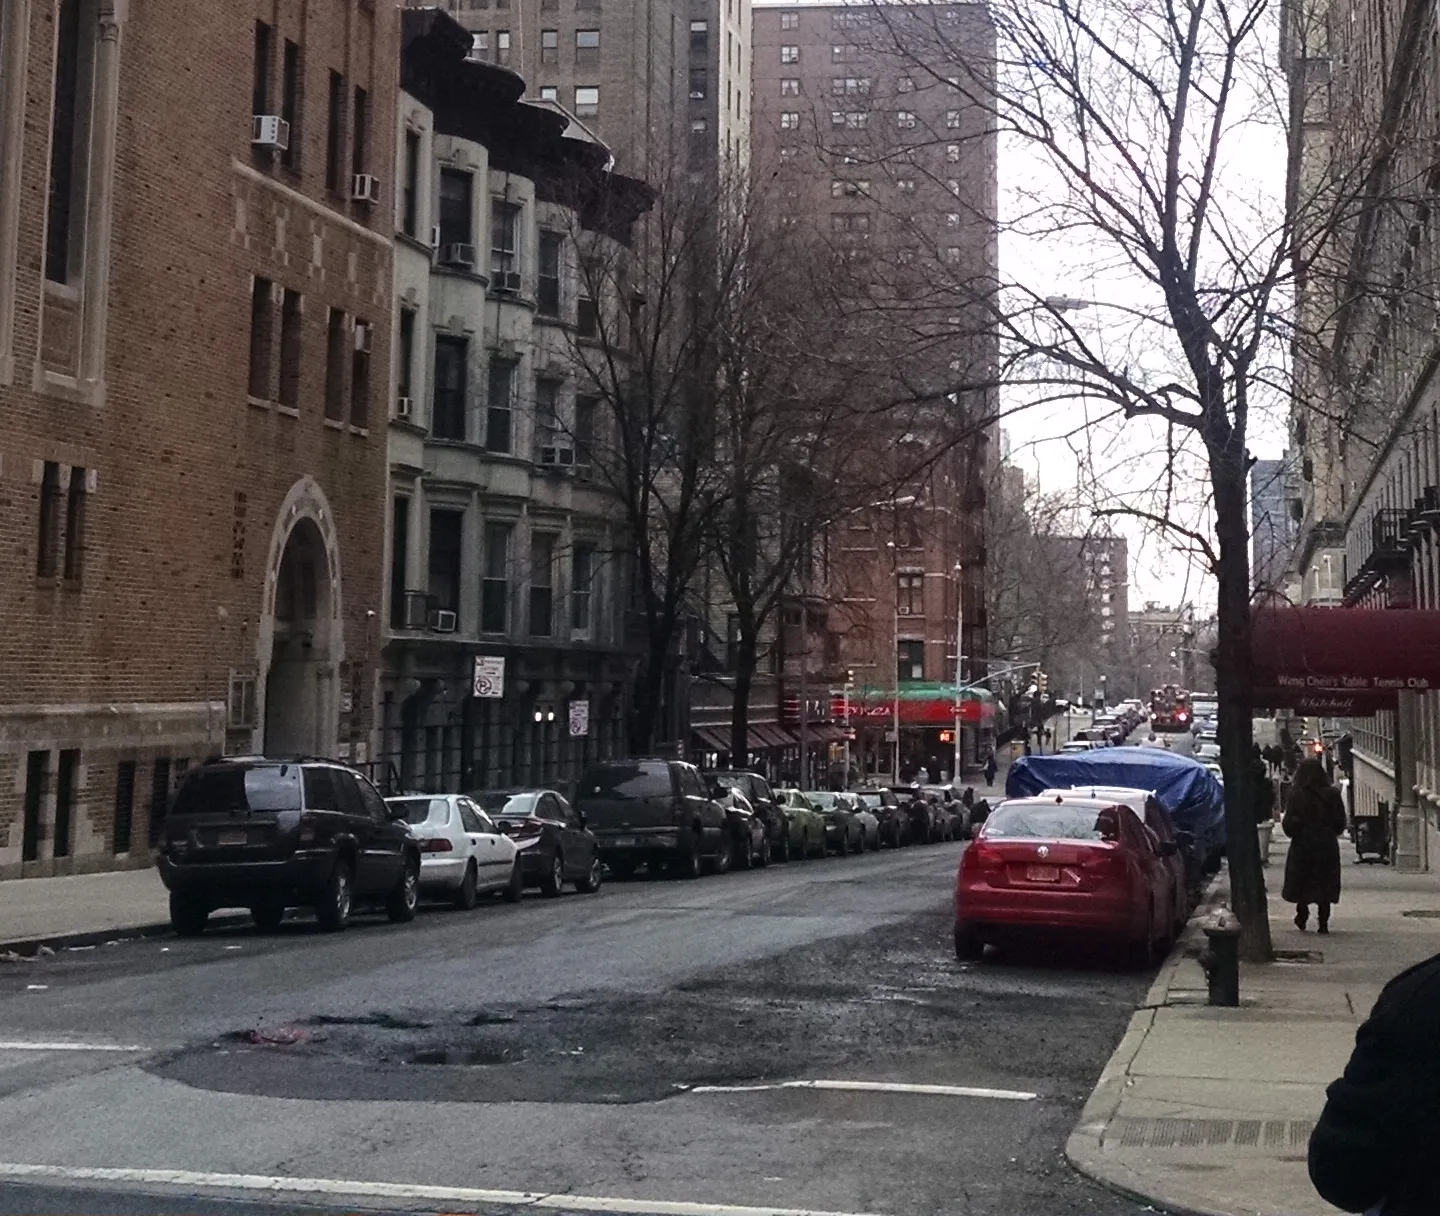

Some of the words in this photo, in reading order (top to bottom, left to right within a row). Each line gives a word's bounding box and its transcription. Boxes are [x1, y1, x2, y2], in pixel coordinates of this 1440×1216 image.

[1279, 676, 1304, 687] Wang
[1342, 675, 1368, 687] Table
[1373, 676, 1404, 688] Tennis
[1408, 677, 1428, 687] Club
